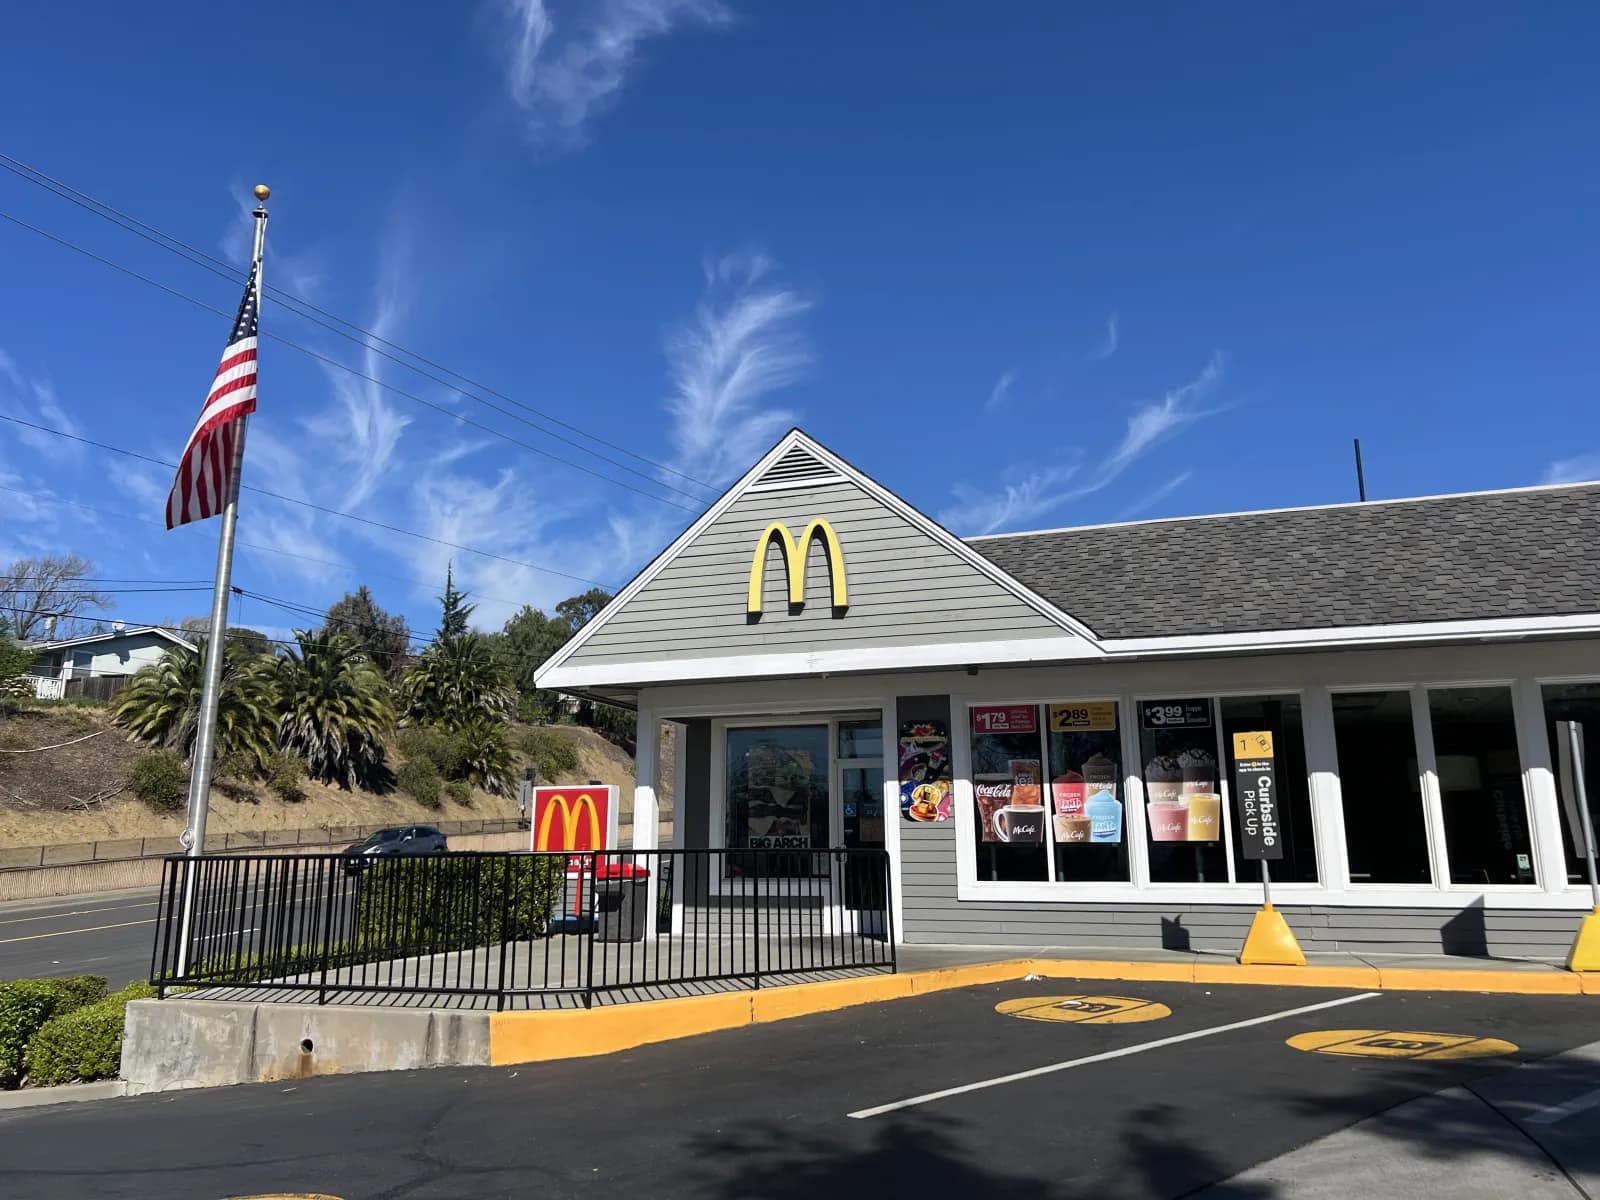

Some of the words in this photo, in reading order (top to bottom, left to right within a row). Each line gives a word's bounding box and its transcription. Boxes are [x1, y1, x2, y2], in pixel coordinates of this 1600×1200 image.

[1239, 739, 1247, 751] 1
[1243, 790, 1258, 816] Pick
[1257, 775, 1277, 847] Curbside
[1244, 818, 1259, 836] Up
[750, 837, 771, 849] BIG
[773, 837, 808, 849] ARCH
